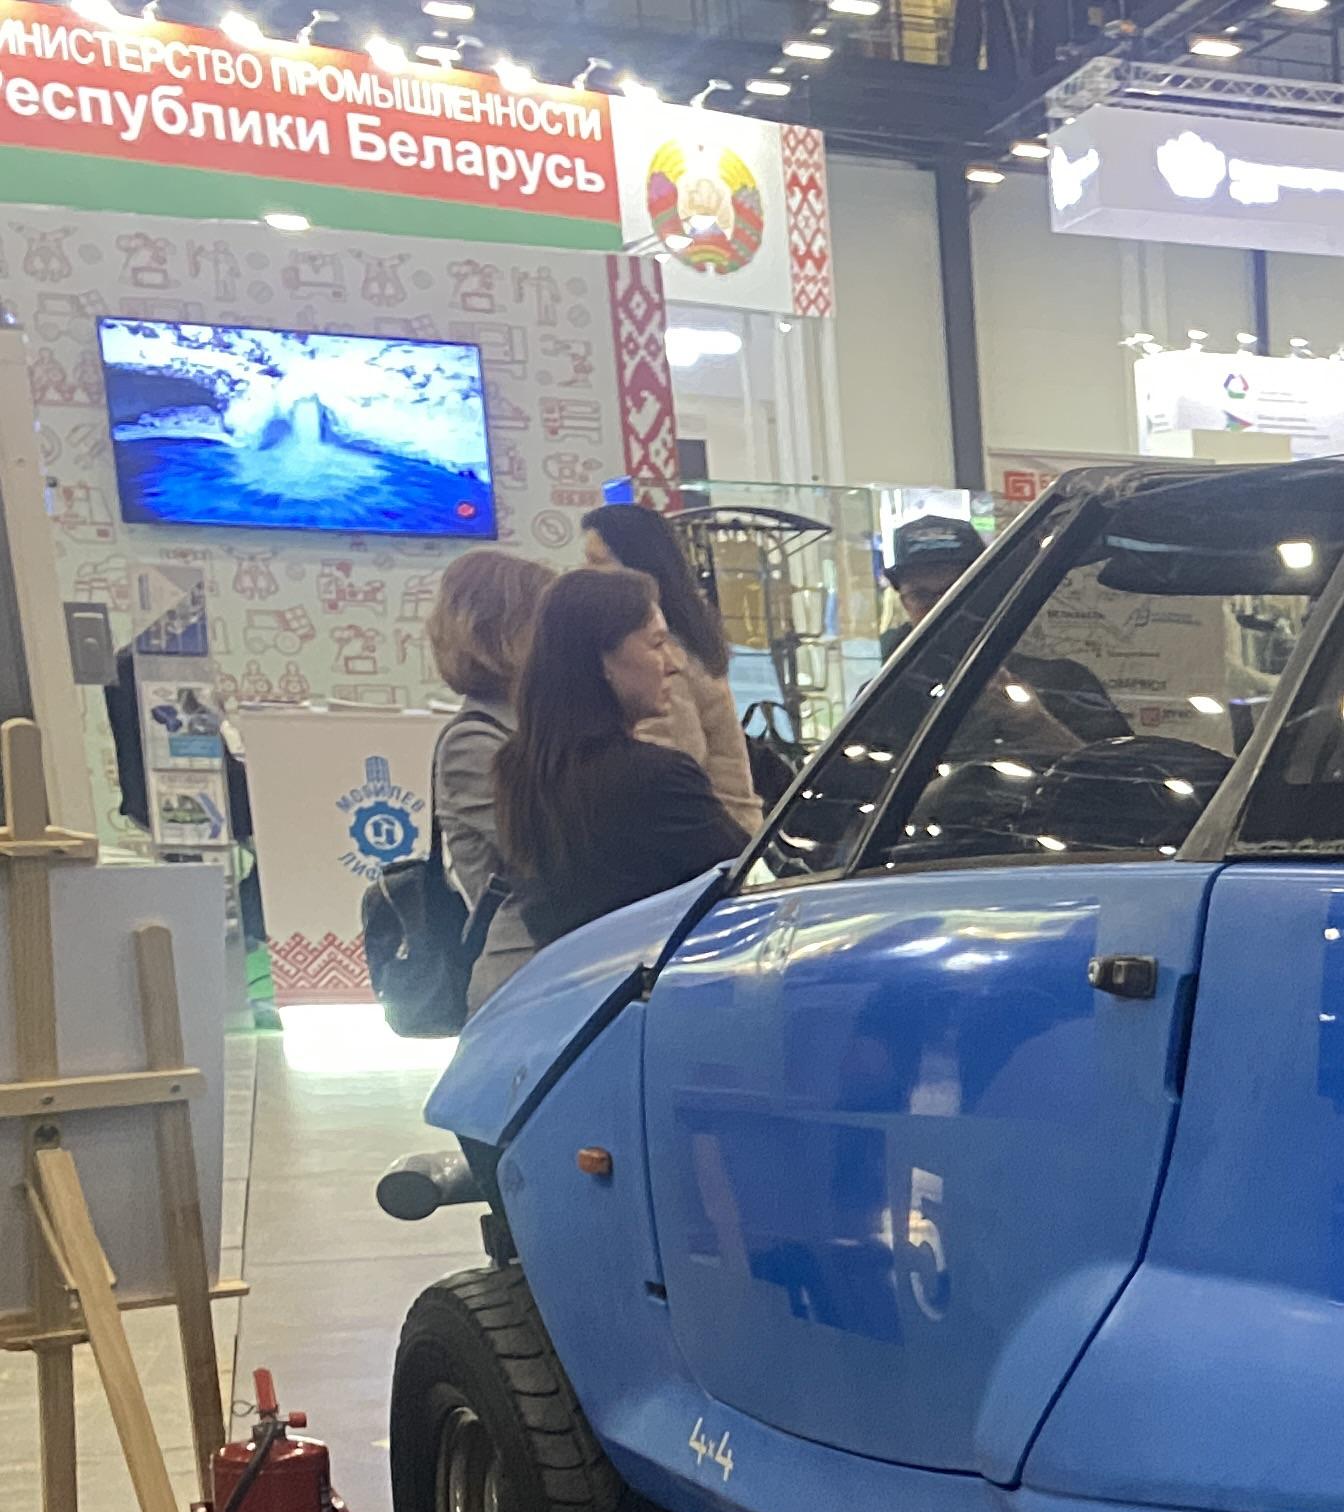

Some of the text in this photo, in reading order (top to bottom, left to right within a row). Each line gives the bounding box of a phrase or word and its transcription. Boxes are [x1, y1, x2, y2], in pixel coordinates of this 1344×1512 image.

[0, 71, 606, 195] еспублики Беларусь
[270, 56, 602, 141] ПРОМЫШЛЕННОСТИ
